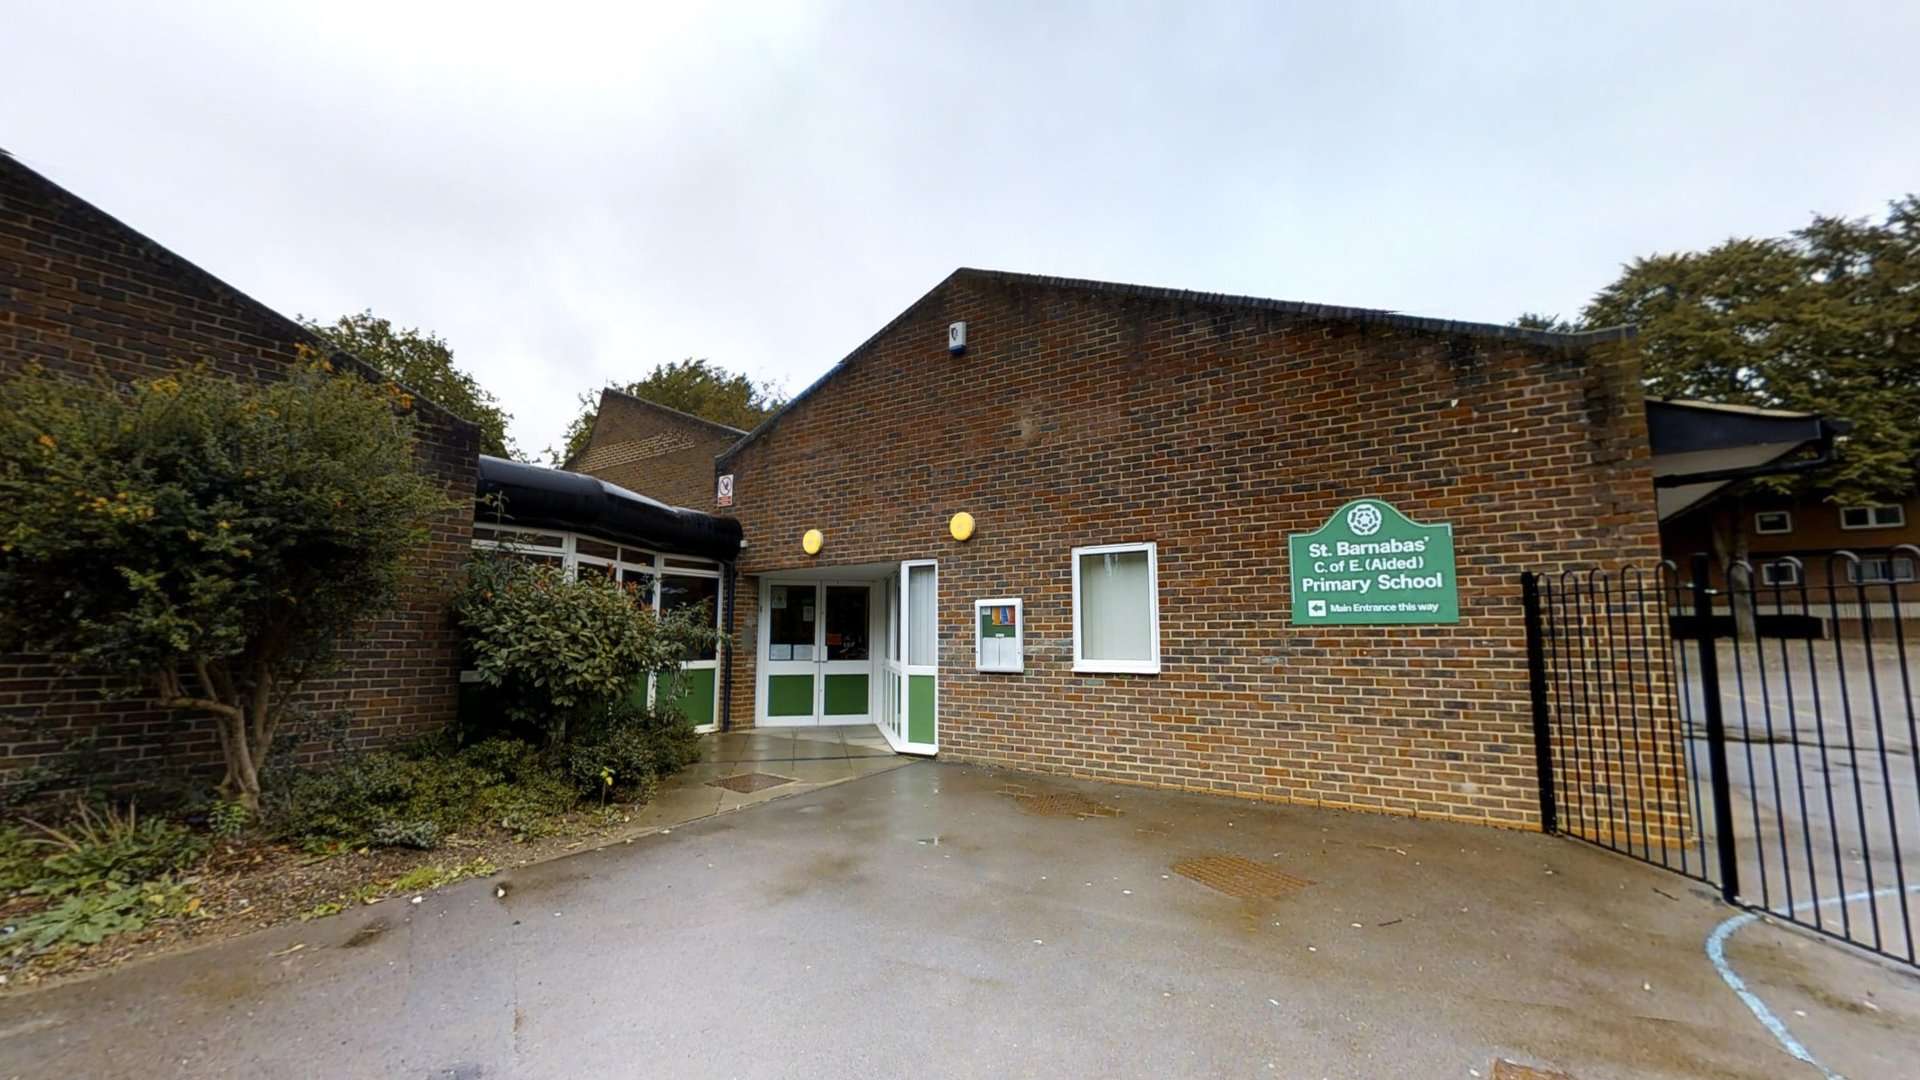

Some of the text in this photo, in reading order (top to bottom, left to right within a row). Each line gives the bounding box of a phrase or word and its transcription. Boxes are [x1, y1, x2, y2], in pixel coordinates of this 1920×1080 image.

[1309, 536, 1429, 558] St. Barnabas'
[1302, 572, 1443, 594] Primary School
[1330, 602, 1439, 613] Main Entrance this way
